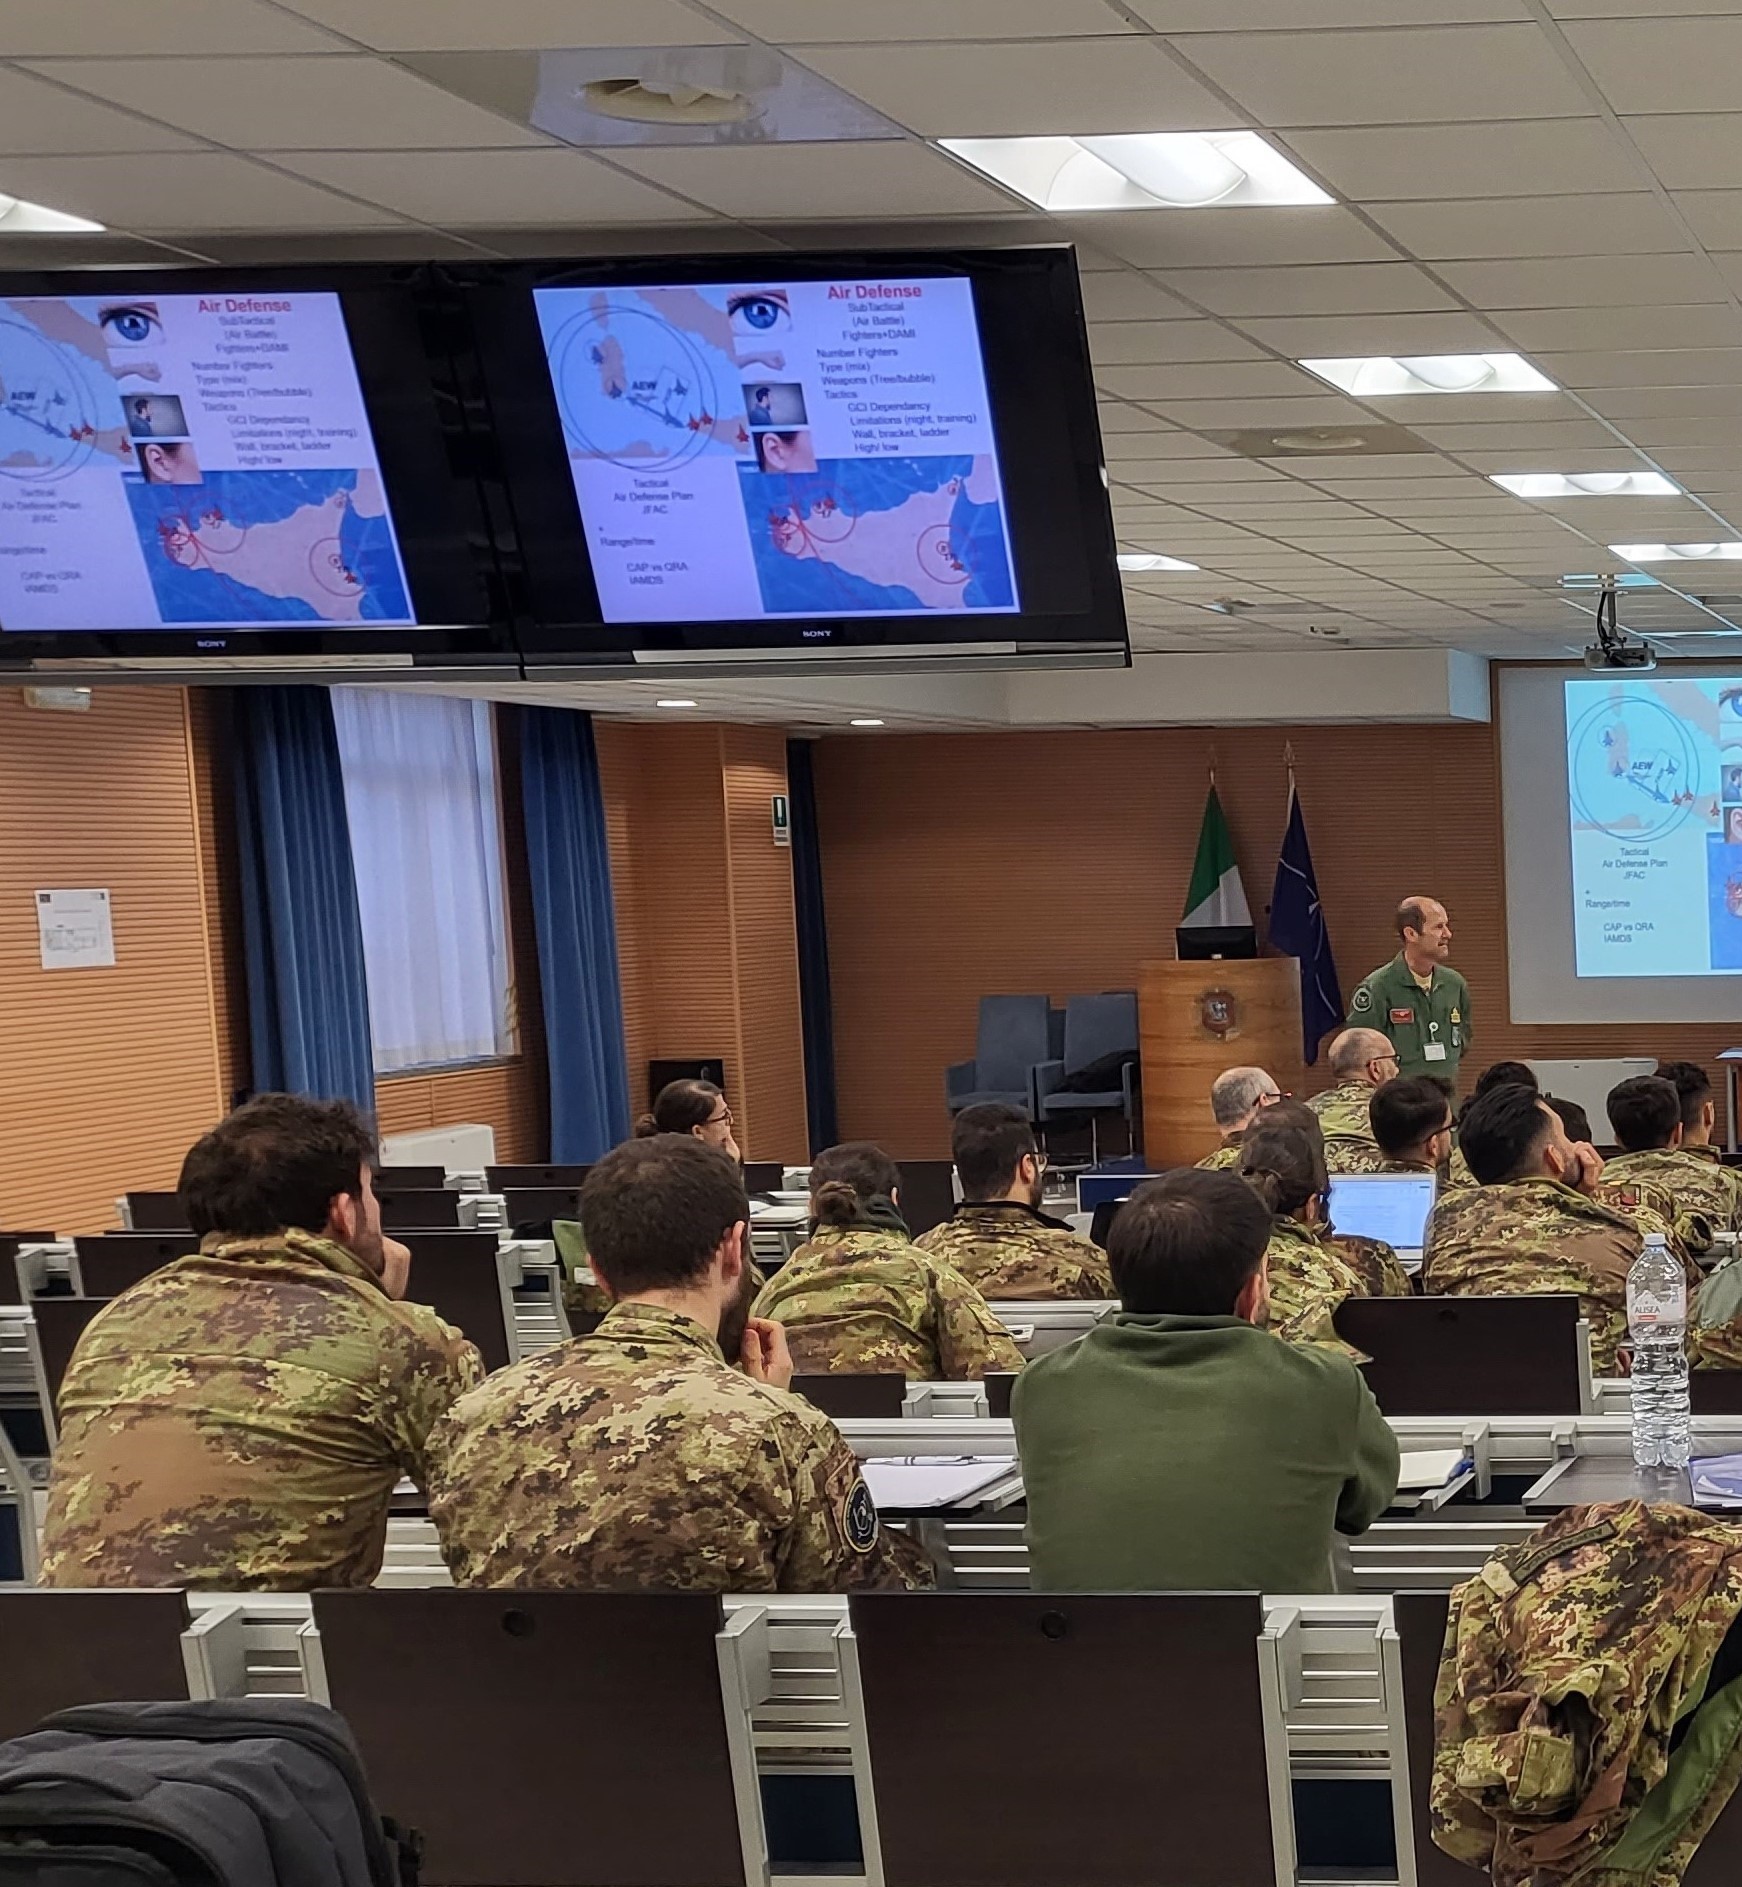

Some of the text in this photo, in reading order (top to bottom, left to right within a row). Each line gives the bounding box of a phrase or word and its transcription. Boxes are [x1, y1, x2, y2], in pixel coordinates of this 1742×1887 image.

[828, 285, 922, 299] Air Defense
[199, 300, 291, 312] Air Defense
[632, 381, 657, 391] AEW
[1632, 762, 1652, 770] AEW
[1620, 848, 1649, 856] Tactical
[1615, 859, 1648, 868] Defense
[1650, 859, 1668, 867] Plan
[1604, 923, 1622, 931] CAP
